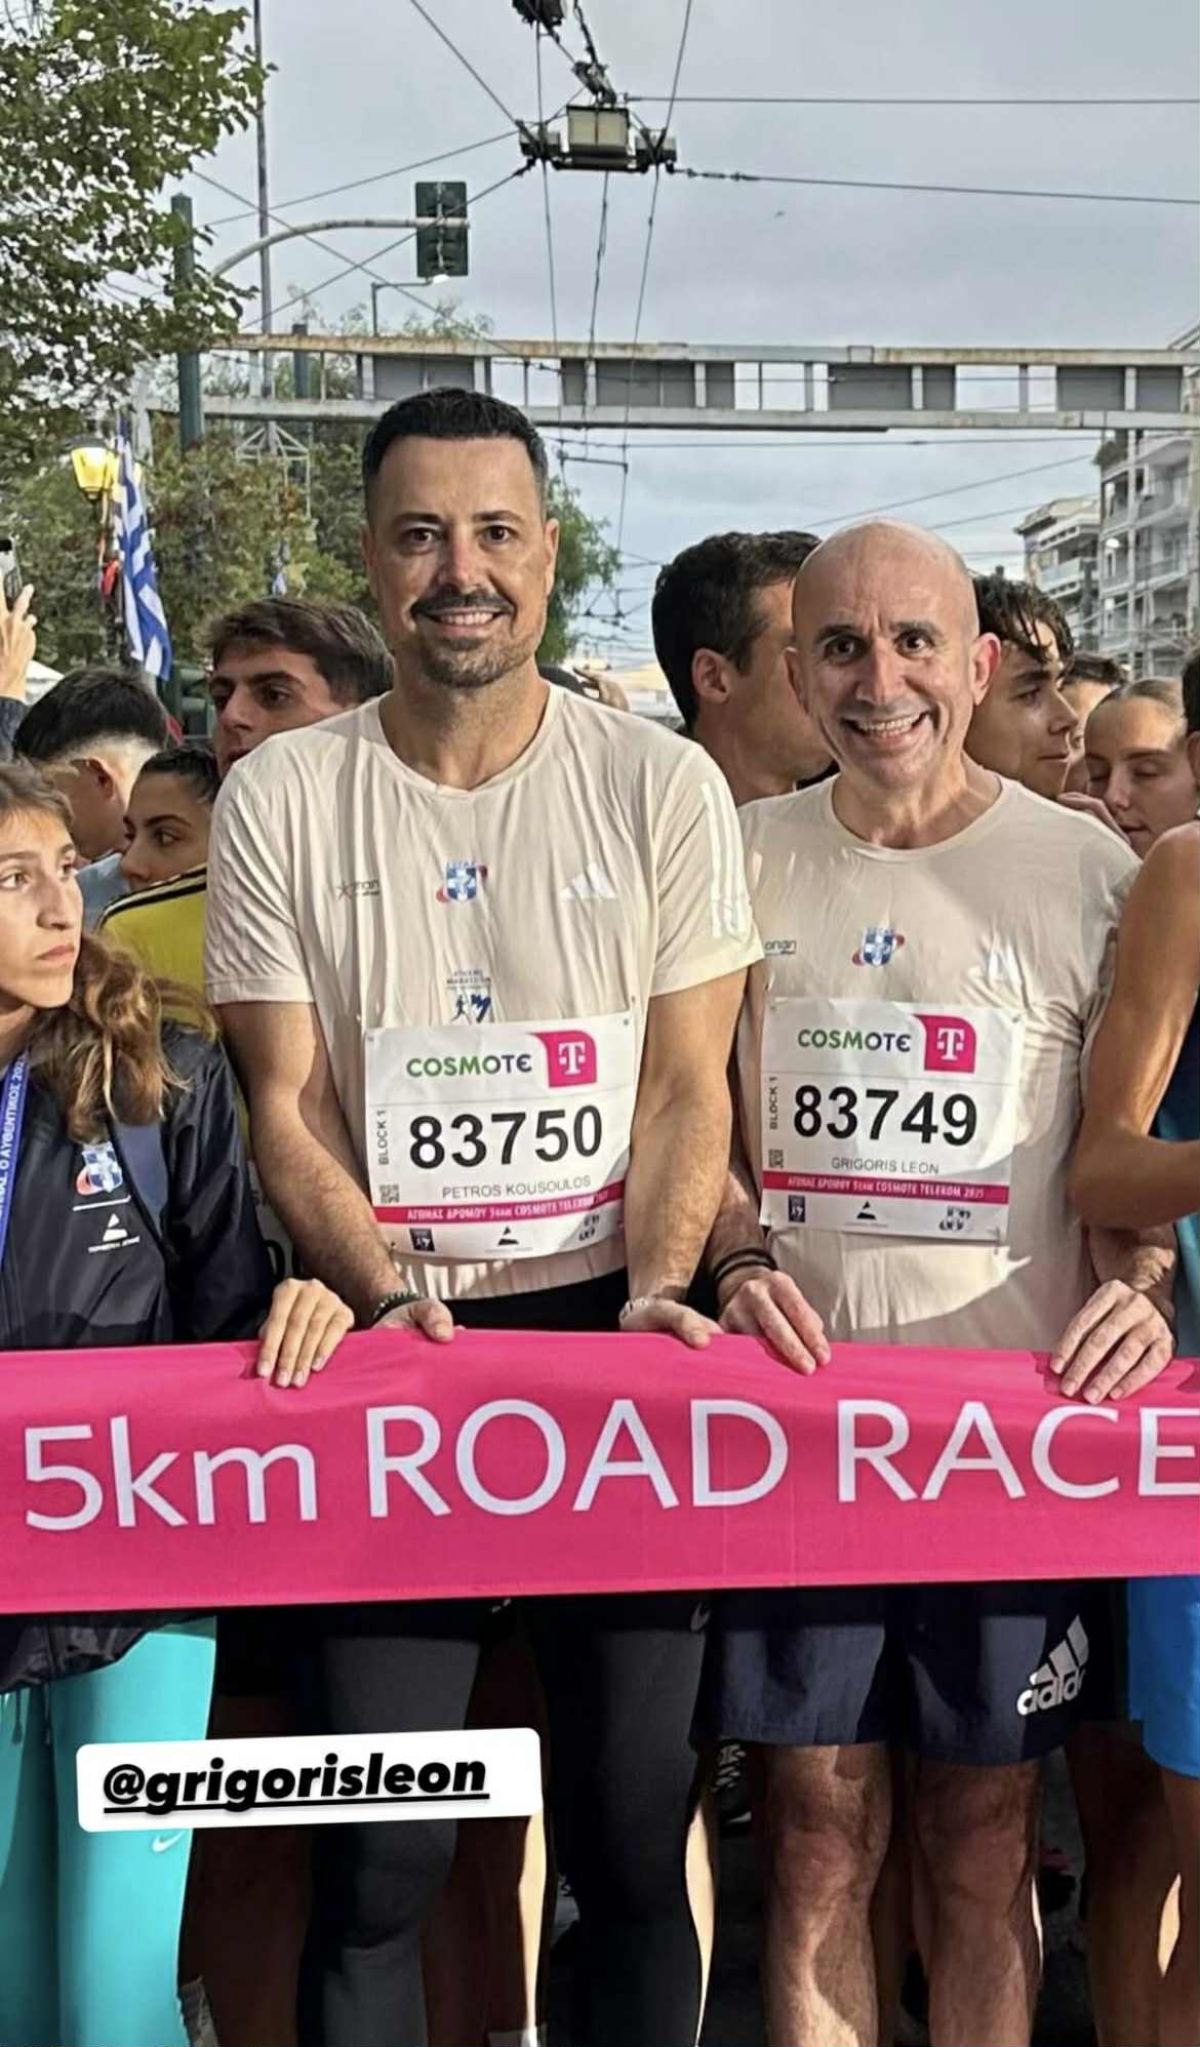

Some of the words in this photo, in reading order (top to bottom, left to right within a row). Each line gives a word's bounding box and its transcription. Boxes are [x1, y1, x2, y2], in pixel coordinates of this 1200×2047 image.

[796, 1029, 912, 1052] COSMOTE
[937, 1028, 965, 1061] T
[406, 1054, 533, 1077] COSMOTE
[558, 1041, 586, 1075] T
[769, 1086, 779, 1130] BLOCK
[794, 1085, 977, 1146] 83749
[378, 1119, 389, 1165] BLOCK
[409, 1105, 602, 1169] 83750
[831, 1156, 898, 1172] GRIGORIS
[901, 1160, 940, 1174] LEON
[442, 1184, 502, 1199] PETROS
[506, 1174, 591, 1196] KOUSOULOS
[920, 1183, 961, 1197] TELEKOM
[24, 1415, 318, 1531] 5km
[365, 1398, 790, 1519] ROAD
[837, 1399, 1200, 1503] RACE
[1016, 1669, 1086, 1716] adid
